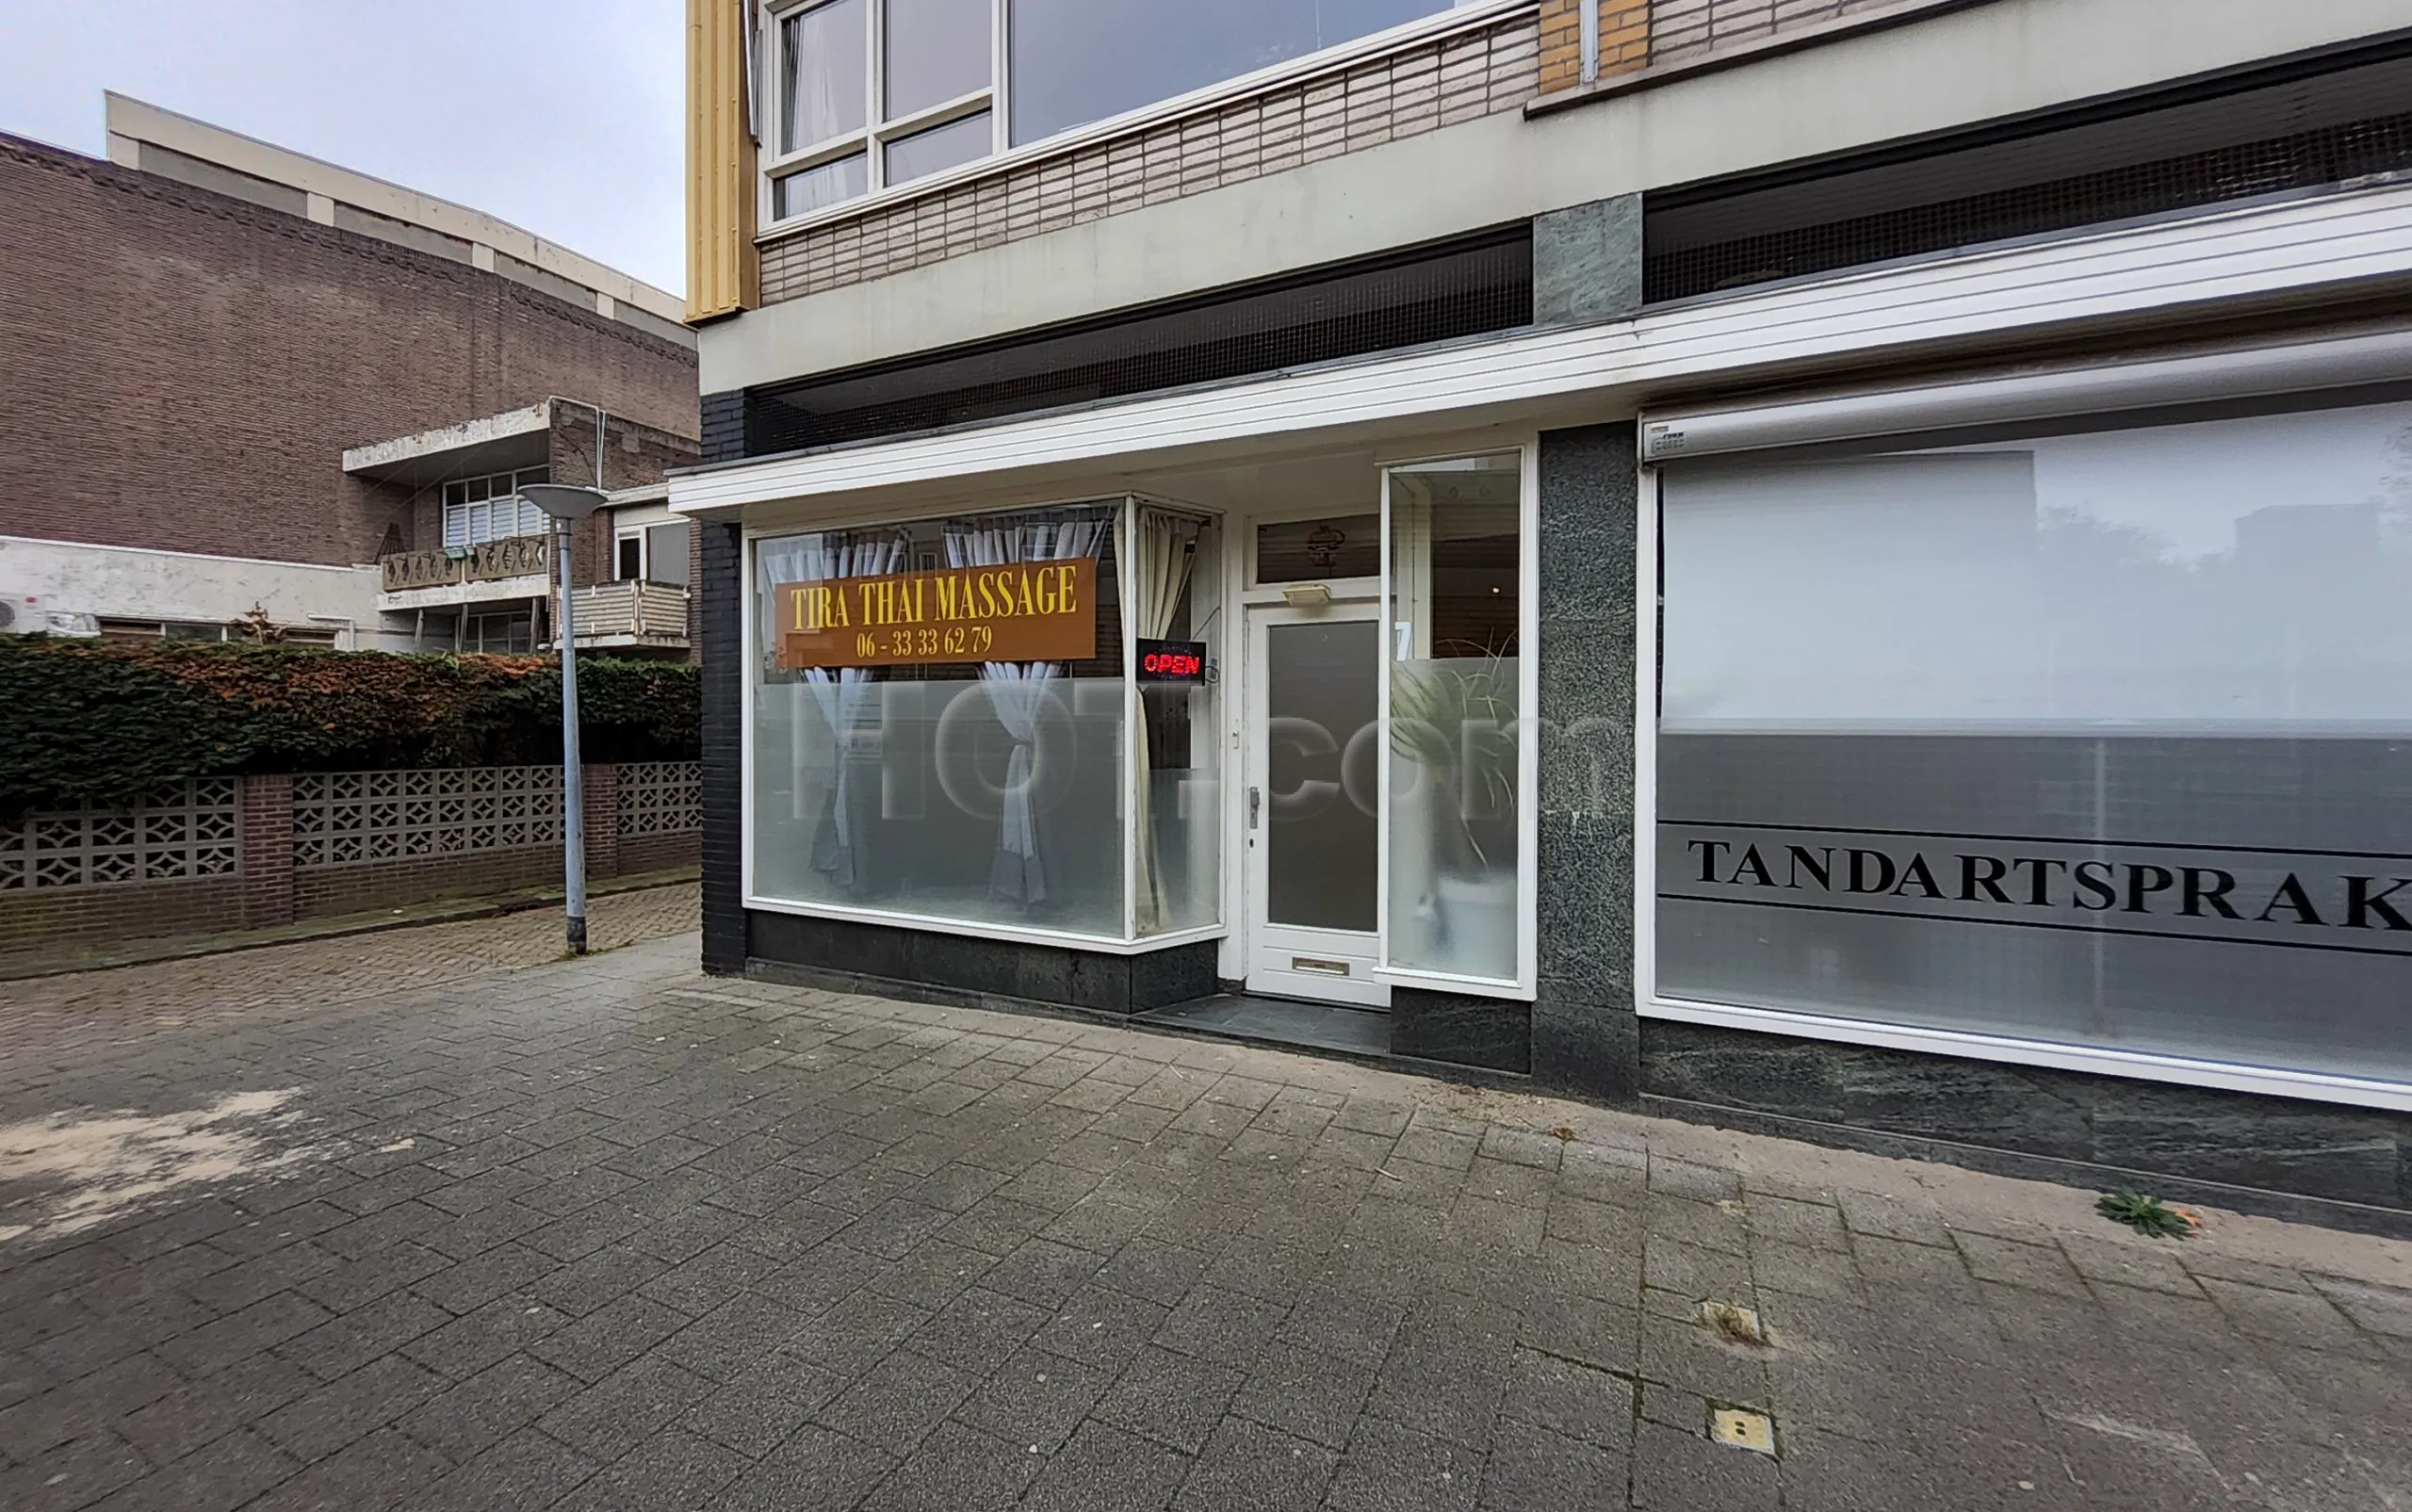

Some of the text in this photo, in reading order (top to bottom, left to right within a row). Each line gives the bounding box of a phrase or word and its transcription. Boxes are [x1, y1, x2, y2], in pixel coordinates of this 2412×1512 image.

[790, 565, 1077, 629] TIRA THAI MASSAGE
[856, 633, 875, 658] 06
[892, 630, 912, 656] 33
[919, 628, 937, 655] 33
[944, 627, 965, 653] 62
[971, 626, 992, 652] 79
[1394, 622, 1411, 661] 7
[1144, 654, 1200, 675] OPEN
[1687, 839, 2412, 931] TANDARTSPRAK
